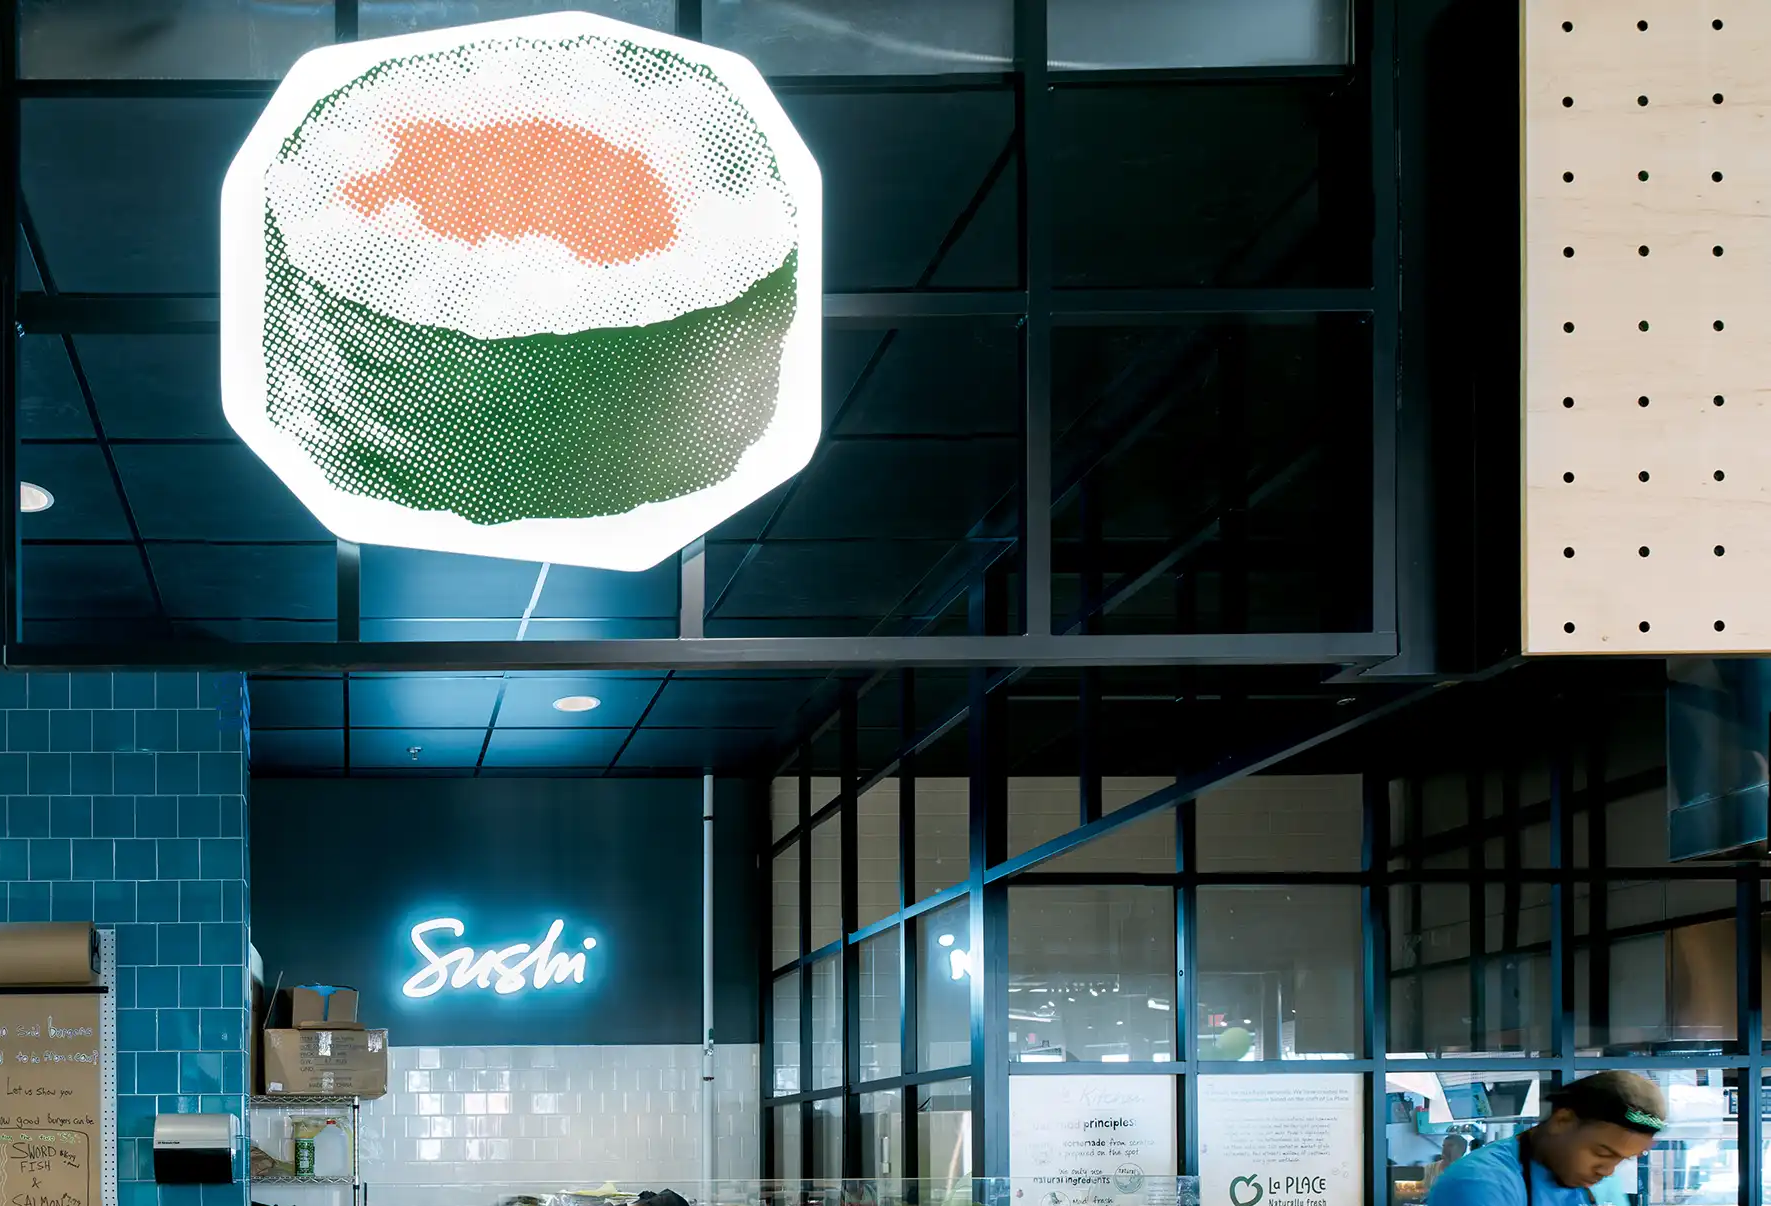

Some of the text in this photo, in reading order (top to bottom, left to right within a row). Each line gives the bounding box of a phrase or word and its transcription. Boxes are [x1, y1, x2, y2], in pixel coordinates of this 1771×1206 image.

[403, 918, 596, 997] Sushi
[7, 1077, 22, 1095] Let
[60, 1089, 73, 1099] you
[16, 1116, 40, 1129] good
[10, 1142, 57, 1160] SWORD
[1124, 1148, 1139, 1159] spot
[20, 1161, 51, 1173] FISH
[1071, 1167, 1088, 1177] only
[1033, 1175, 1110, 1186] natural ingredients
[1269, 1176, 1327, 1194] La PLACE
